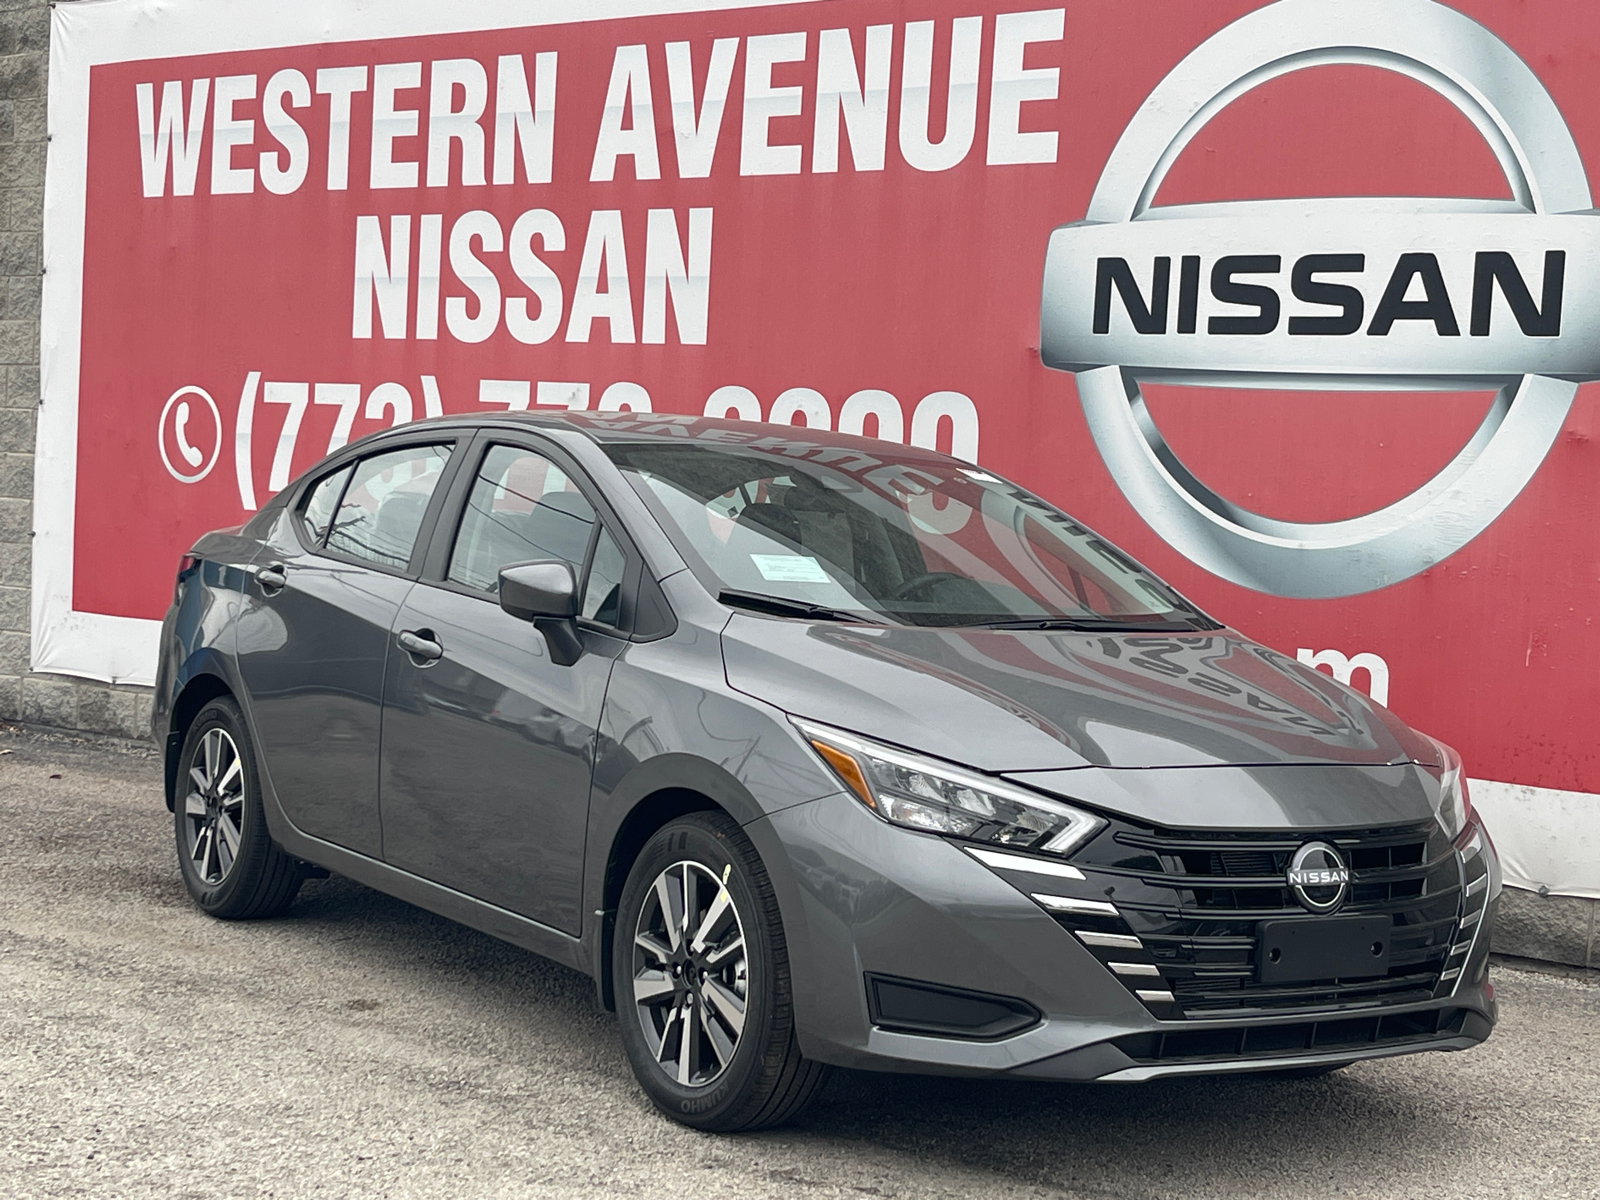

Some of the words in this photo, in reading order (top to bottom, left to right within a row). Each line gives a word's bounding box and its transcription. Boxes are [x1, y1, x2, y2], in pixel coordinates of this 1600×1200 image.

[136, 51, 558, 198] WESTERN
[589, 8, 1066, 183] AVENUE
[353, 208, 713, 345] NISSAN
[1093, 251, 1565, 336] NISSAN
[1289, 870, 1349, 884] NISSAN
[681, 1082, 730, 1113] KUMHO
